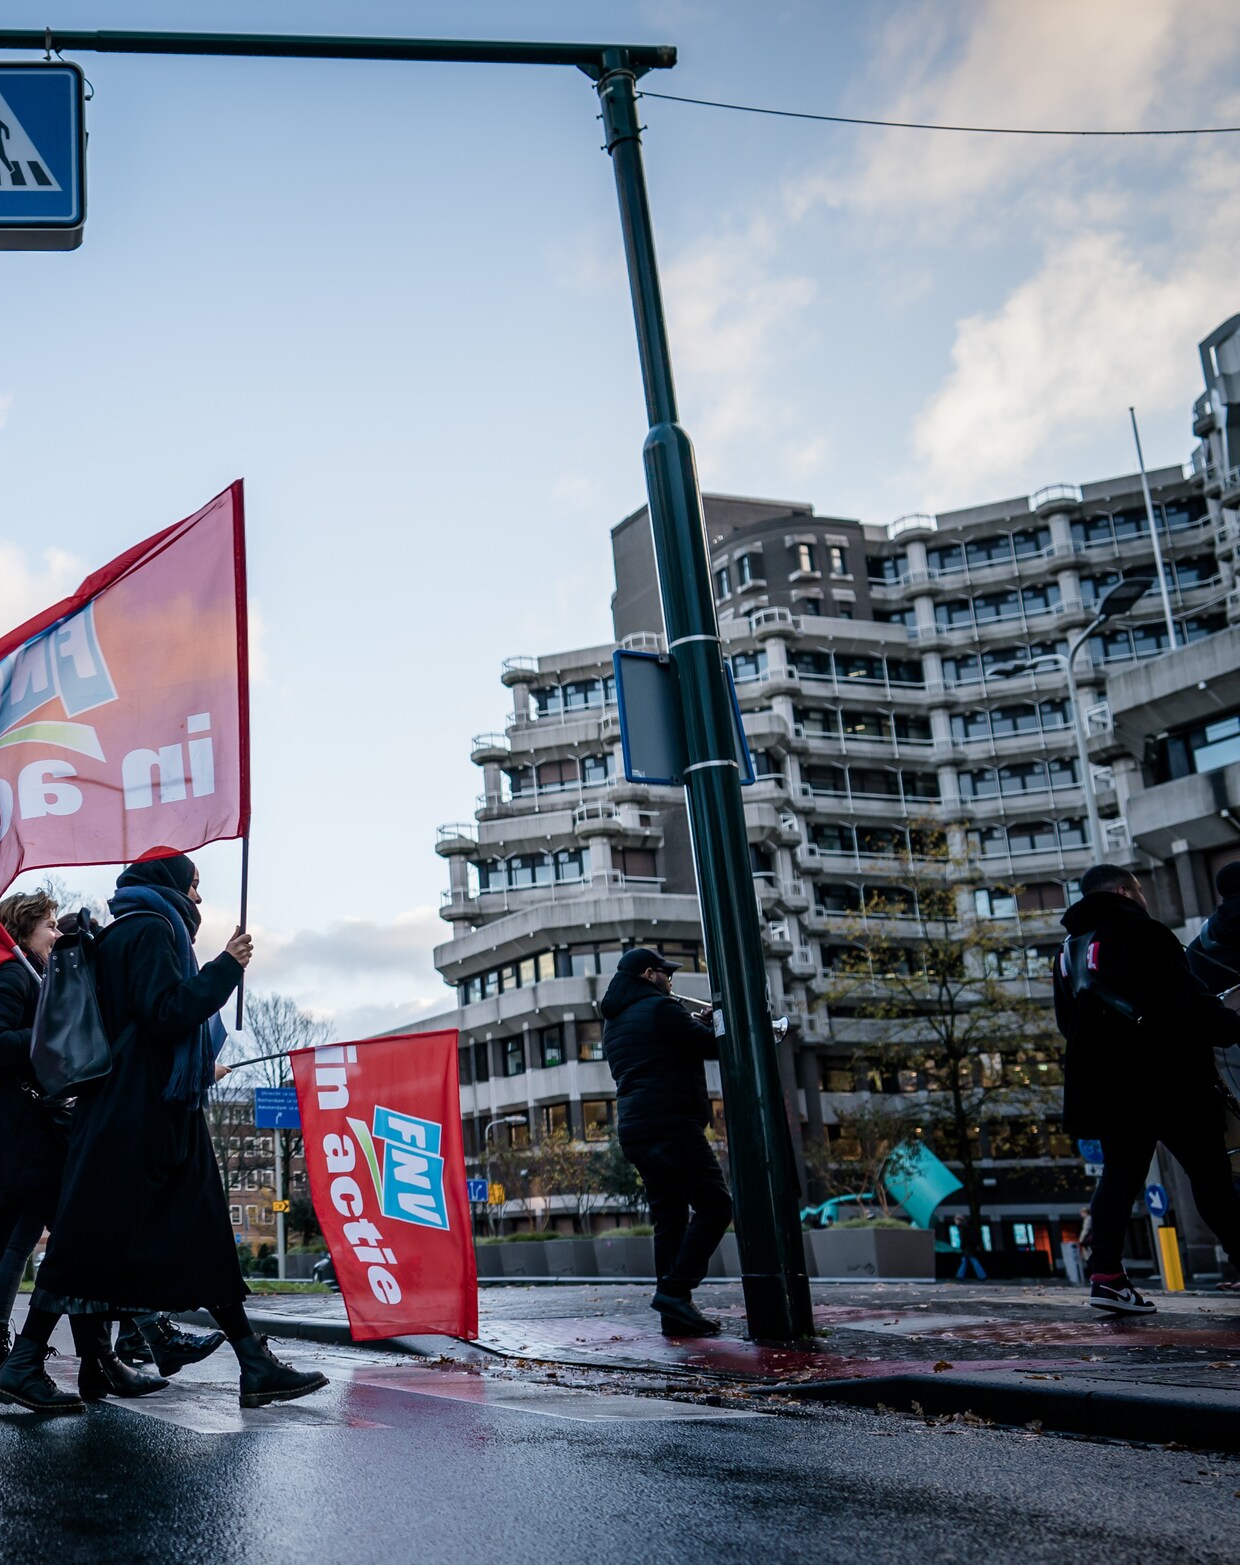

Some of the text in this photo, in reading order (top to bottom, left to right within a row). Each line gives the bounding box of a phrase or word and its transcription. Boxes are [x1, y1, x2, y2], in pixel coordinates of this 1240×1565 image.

[315, 1044, 402, 1305] in actie
[387, 1115, 443, 1226] FNV
